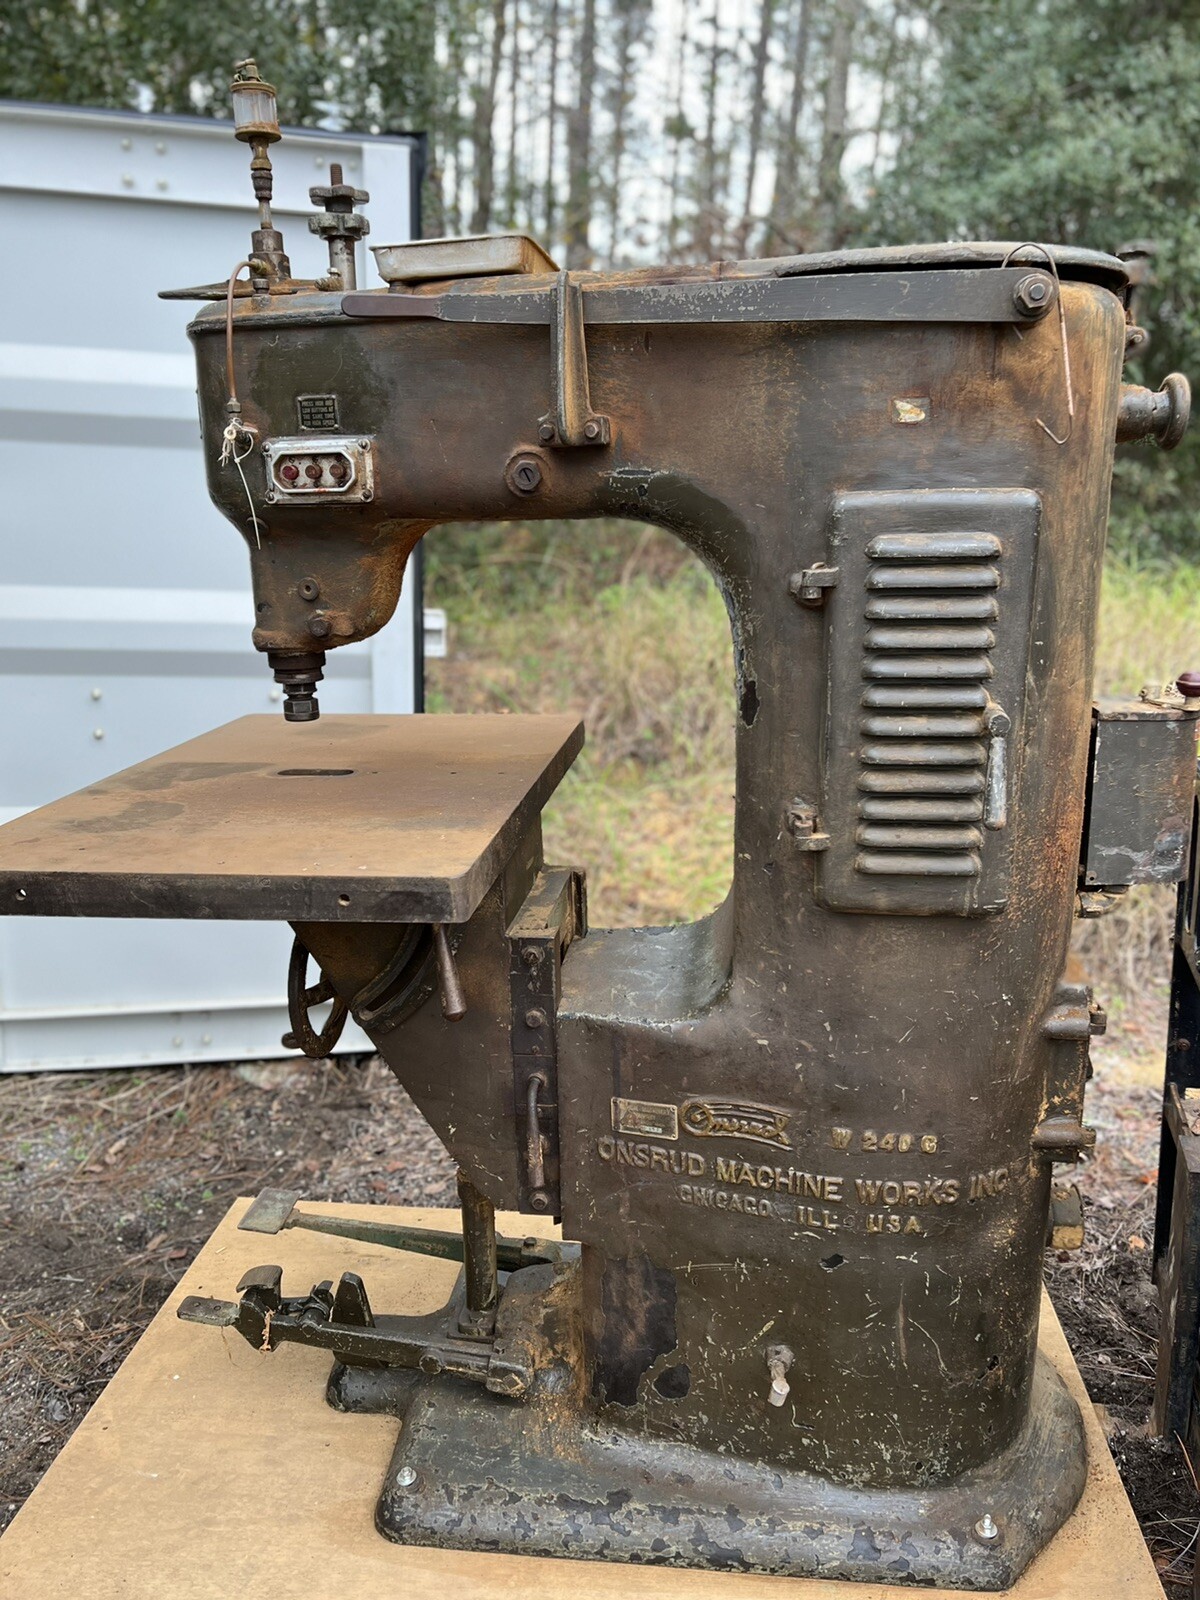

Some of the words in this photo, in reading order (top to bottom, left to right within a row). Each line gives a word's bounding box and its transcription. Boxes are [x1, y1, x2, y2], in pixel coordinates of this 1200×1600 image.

[831, 1126, 852, 1149] W
[597, 1135, 705, 1177] ONSRUD
[715, 1156, 844, 1202] MACHINE
[854, 1177, 961, 1206] WORKS
[679, 1184, 773, 1218] CHICAGO
